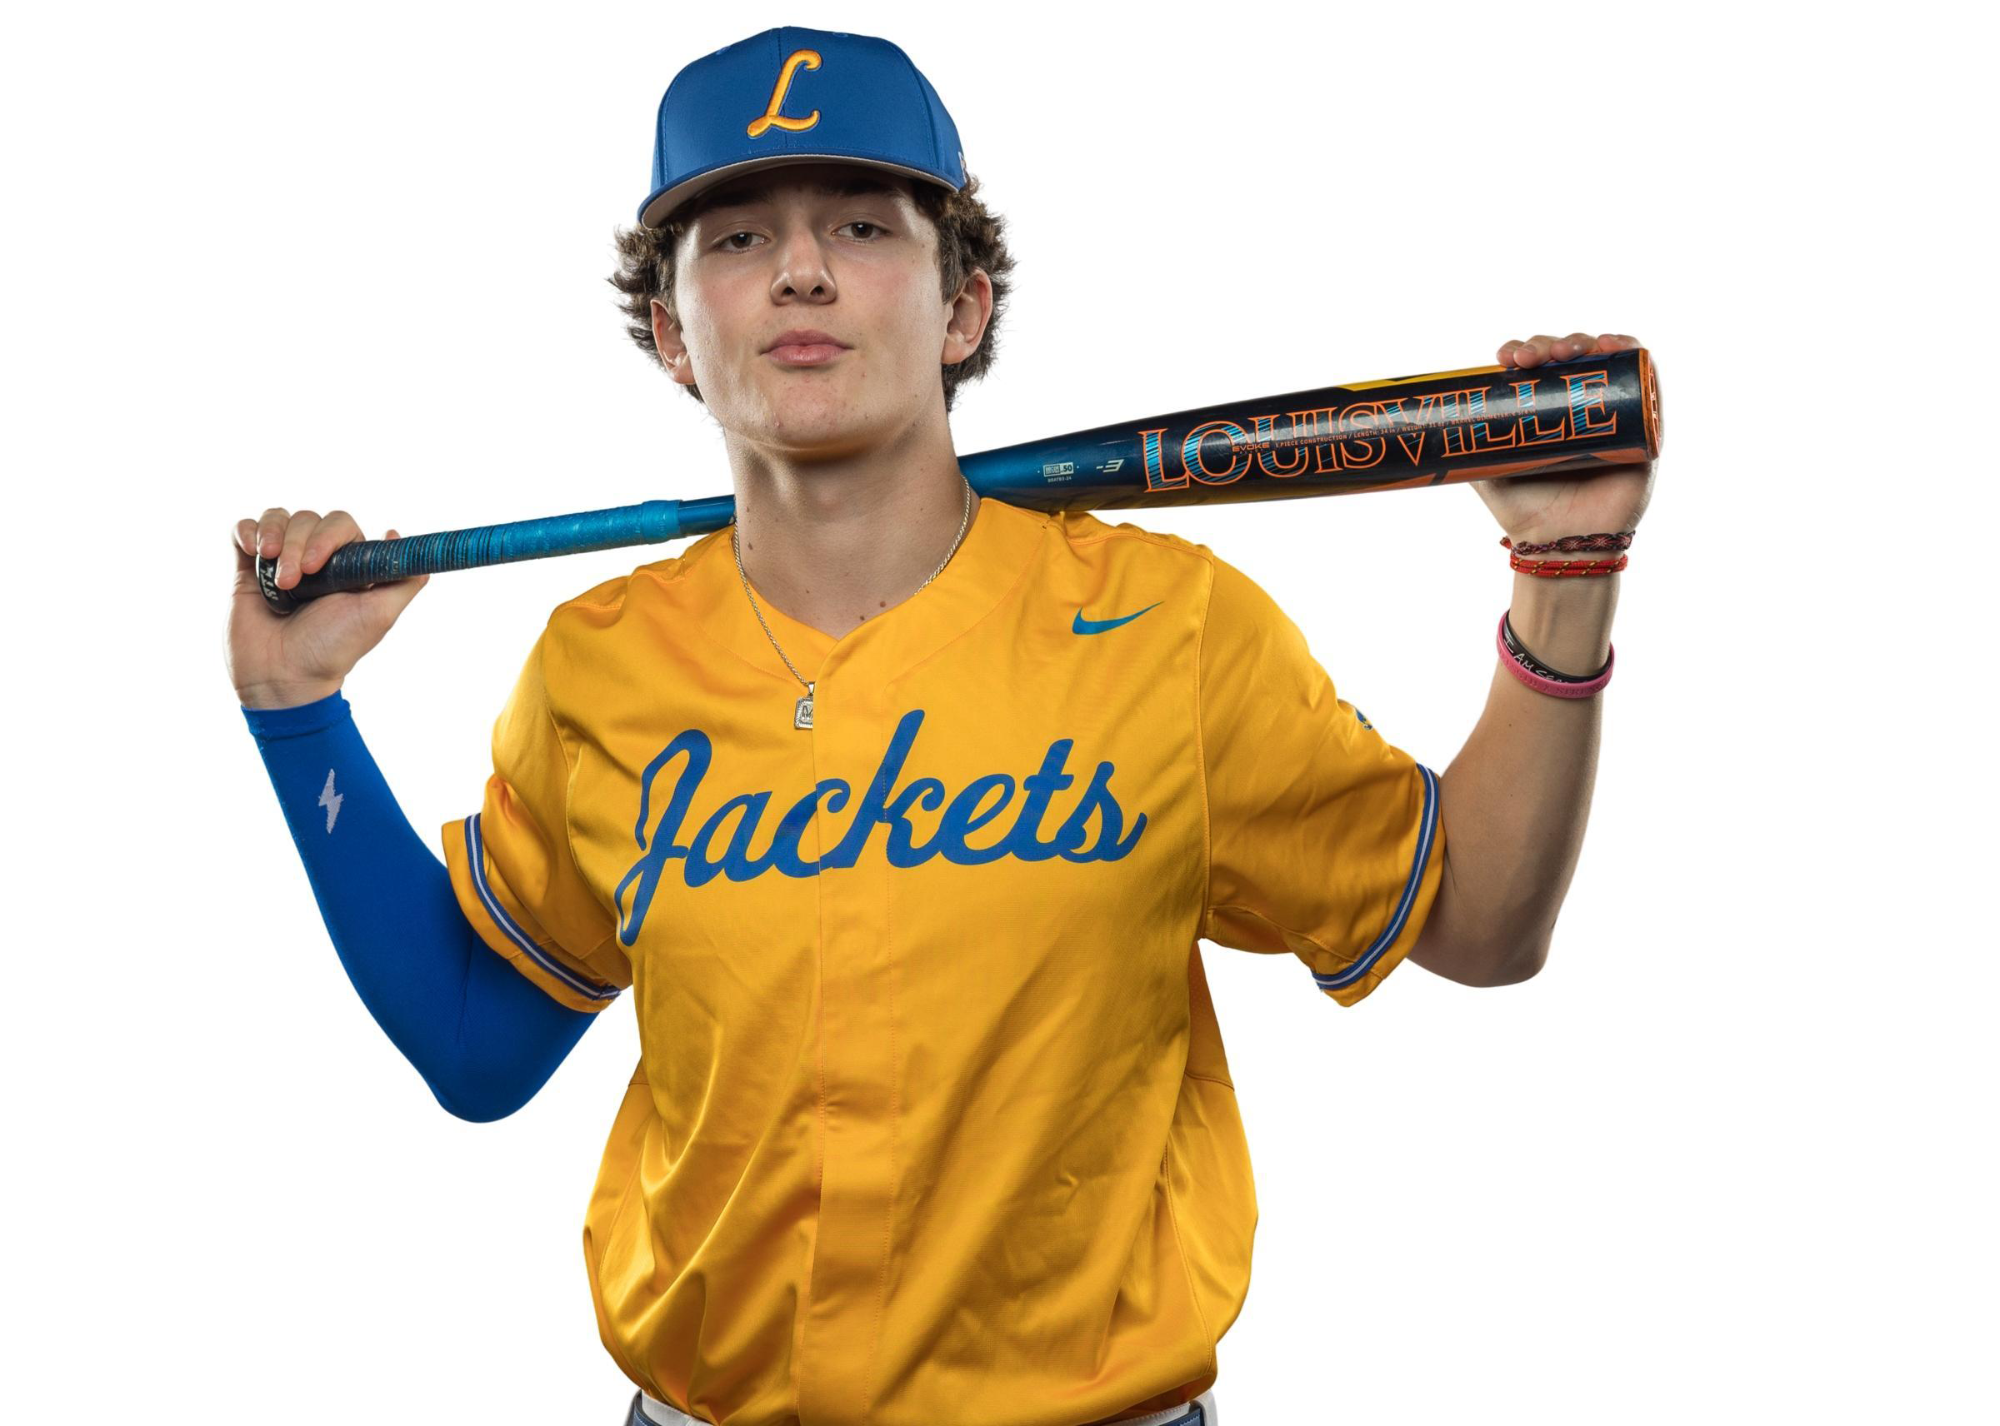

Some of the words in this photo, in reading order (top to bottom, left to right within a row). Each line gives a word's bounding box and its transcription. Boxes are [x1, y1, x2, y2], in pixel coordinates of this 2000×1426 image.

[746, 48, 823, 140] L
[1137, 370, 1618, 493] LOUISVILLE
[1300, 434, 1347, 445] CONSTRUCTION
[1096, 459, 1125, 473] -3
[1513, 653, 1534, 672] AM
[614, 709, 1147, 947] Jackets
